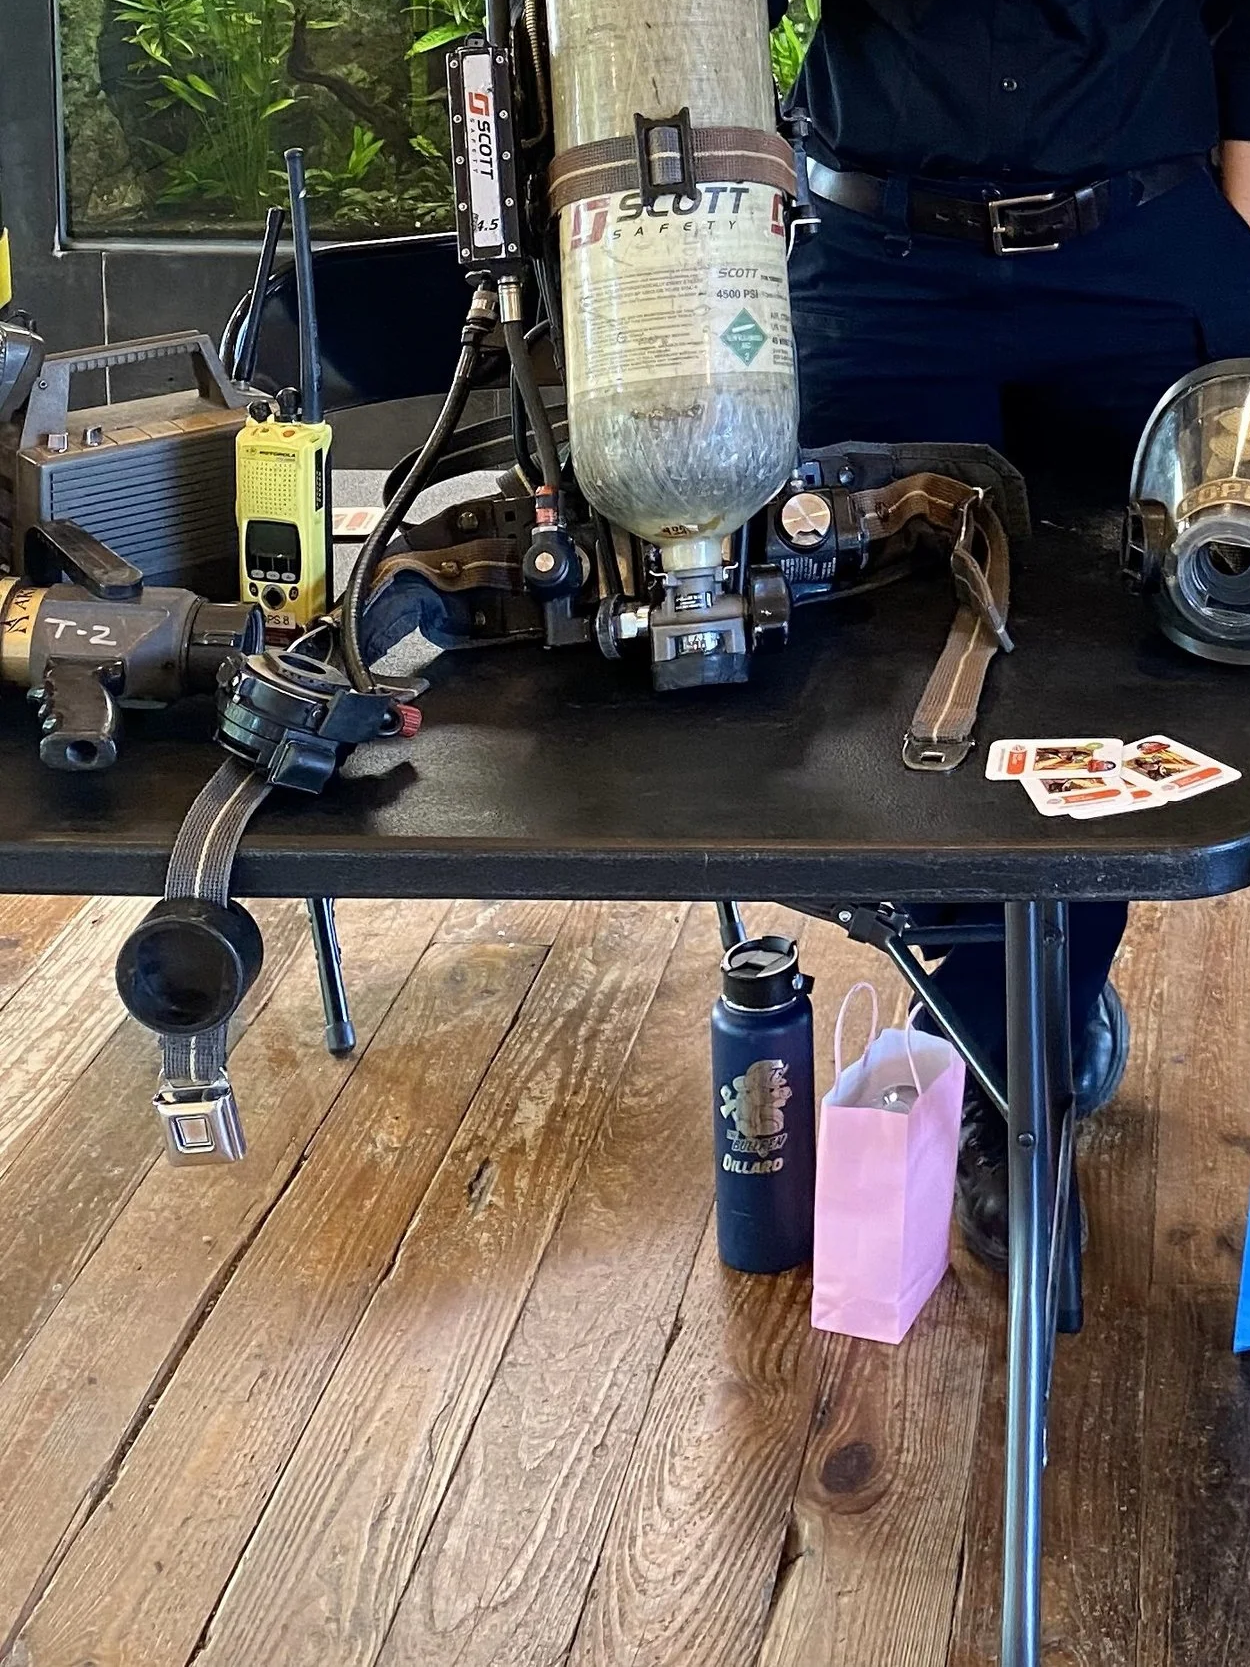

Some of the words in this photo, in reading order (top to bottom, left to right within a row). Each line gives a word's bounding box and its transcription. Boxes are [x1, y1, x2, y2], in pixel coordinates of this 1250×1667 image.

[469, 118, 479, 174] SAFETY
[477, 119, 495, 180] SCOTT
[612, 220, 737, 240] SAFETY
[718, 268, 759, 278] SCOTT
[716, 289, 741, 299] 4500
[743, 289, 759, 299] PSI
[282, 615, 290, 626] 8
[44, 617, 117, 646] T-2
[722, 1153, 784, 1175] DILLARD
